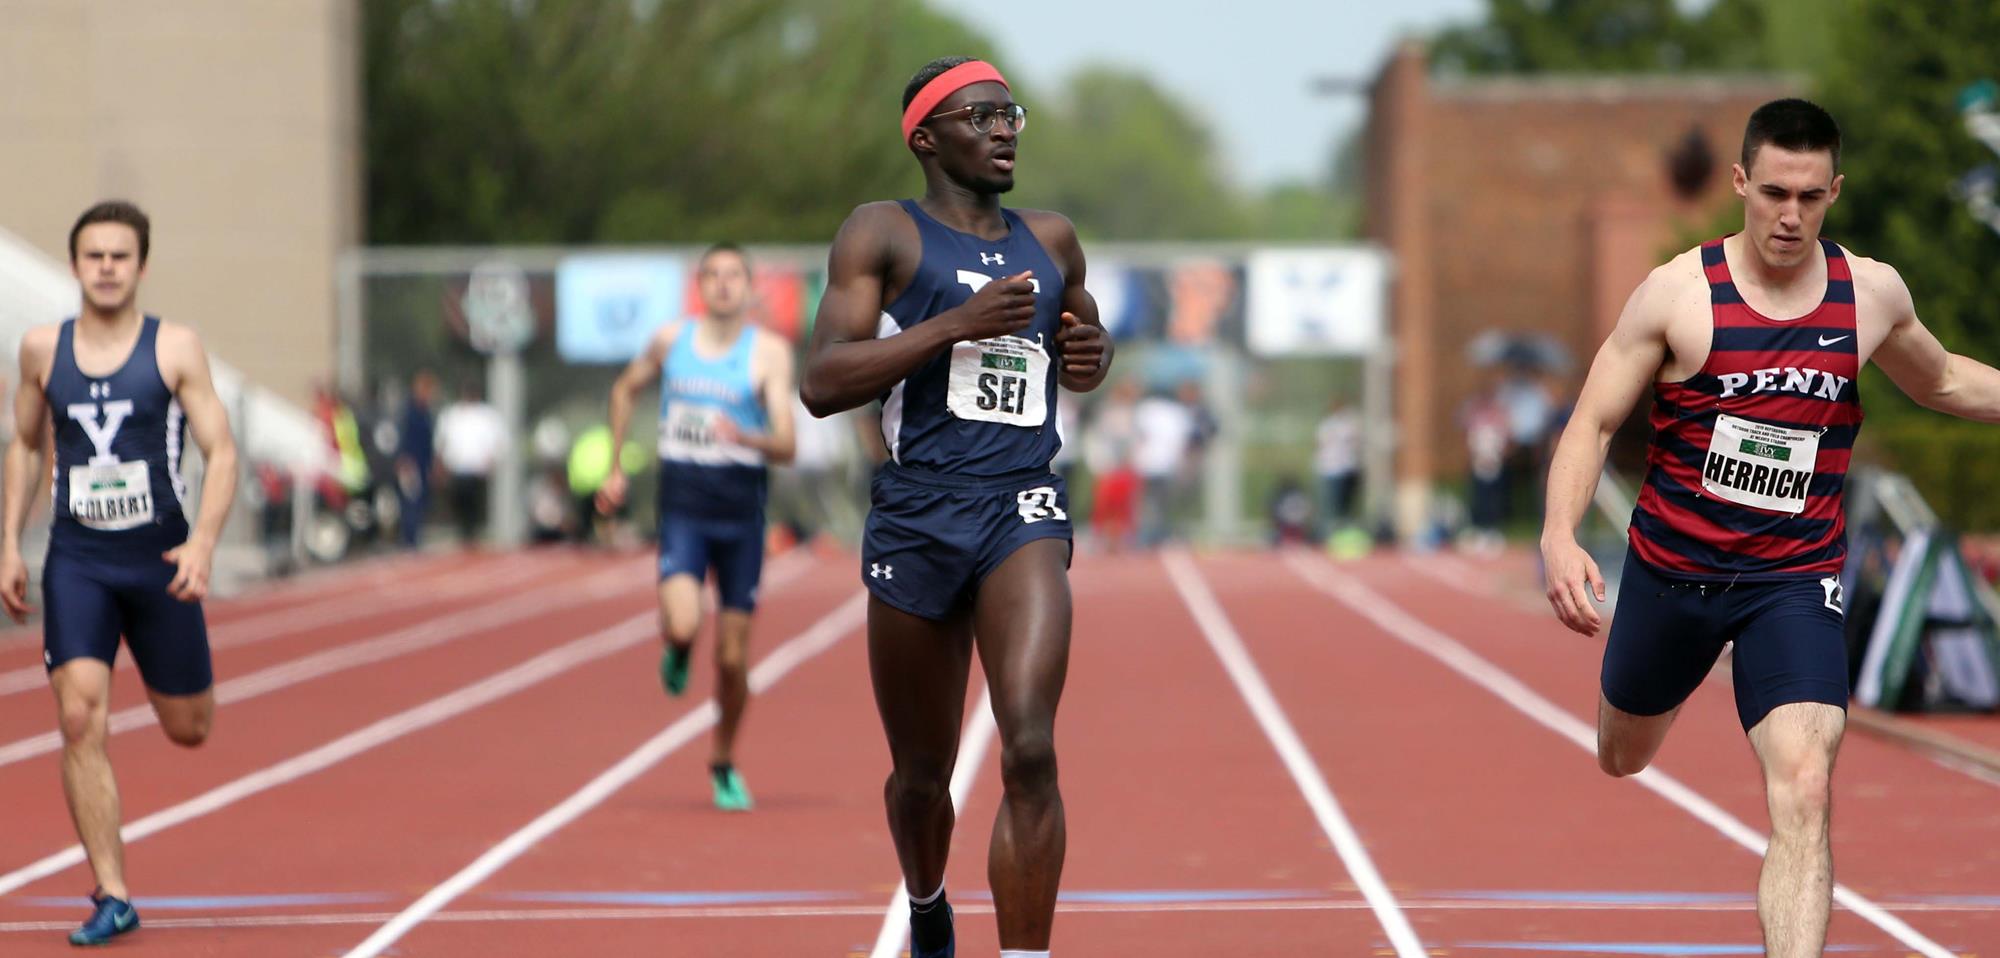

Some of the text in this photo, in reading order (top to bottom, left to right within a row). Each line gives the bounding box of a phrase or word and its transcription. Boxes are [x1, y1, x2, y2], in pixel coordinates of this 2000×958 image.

[976, 372, 1027, 415] SEI
[1717, 367, 1849, 402] PENN
[67, 399, 134, 466] Y
[1760, 446, 1776, 455] IVY
[1705, 451, 1811, 500] HERRICK
